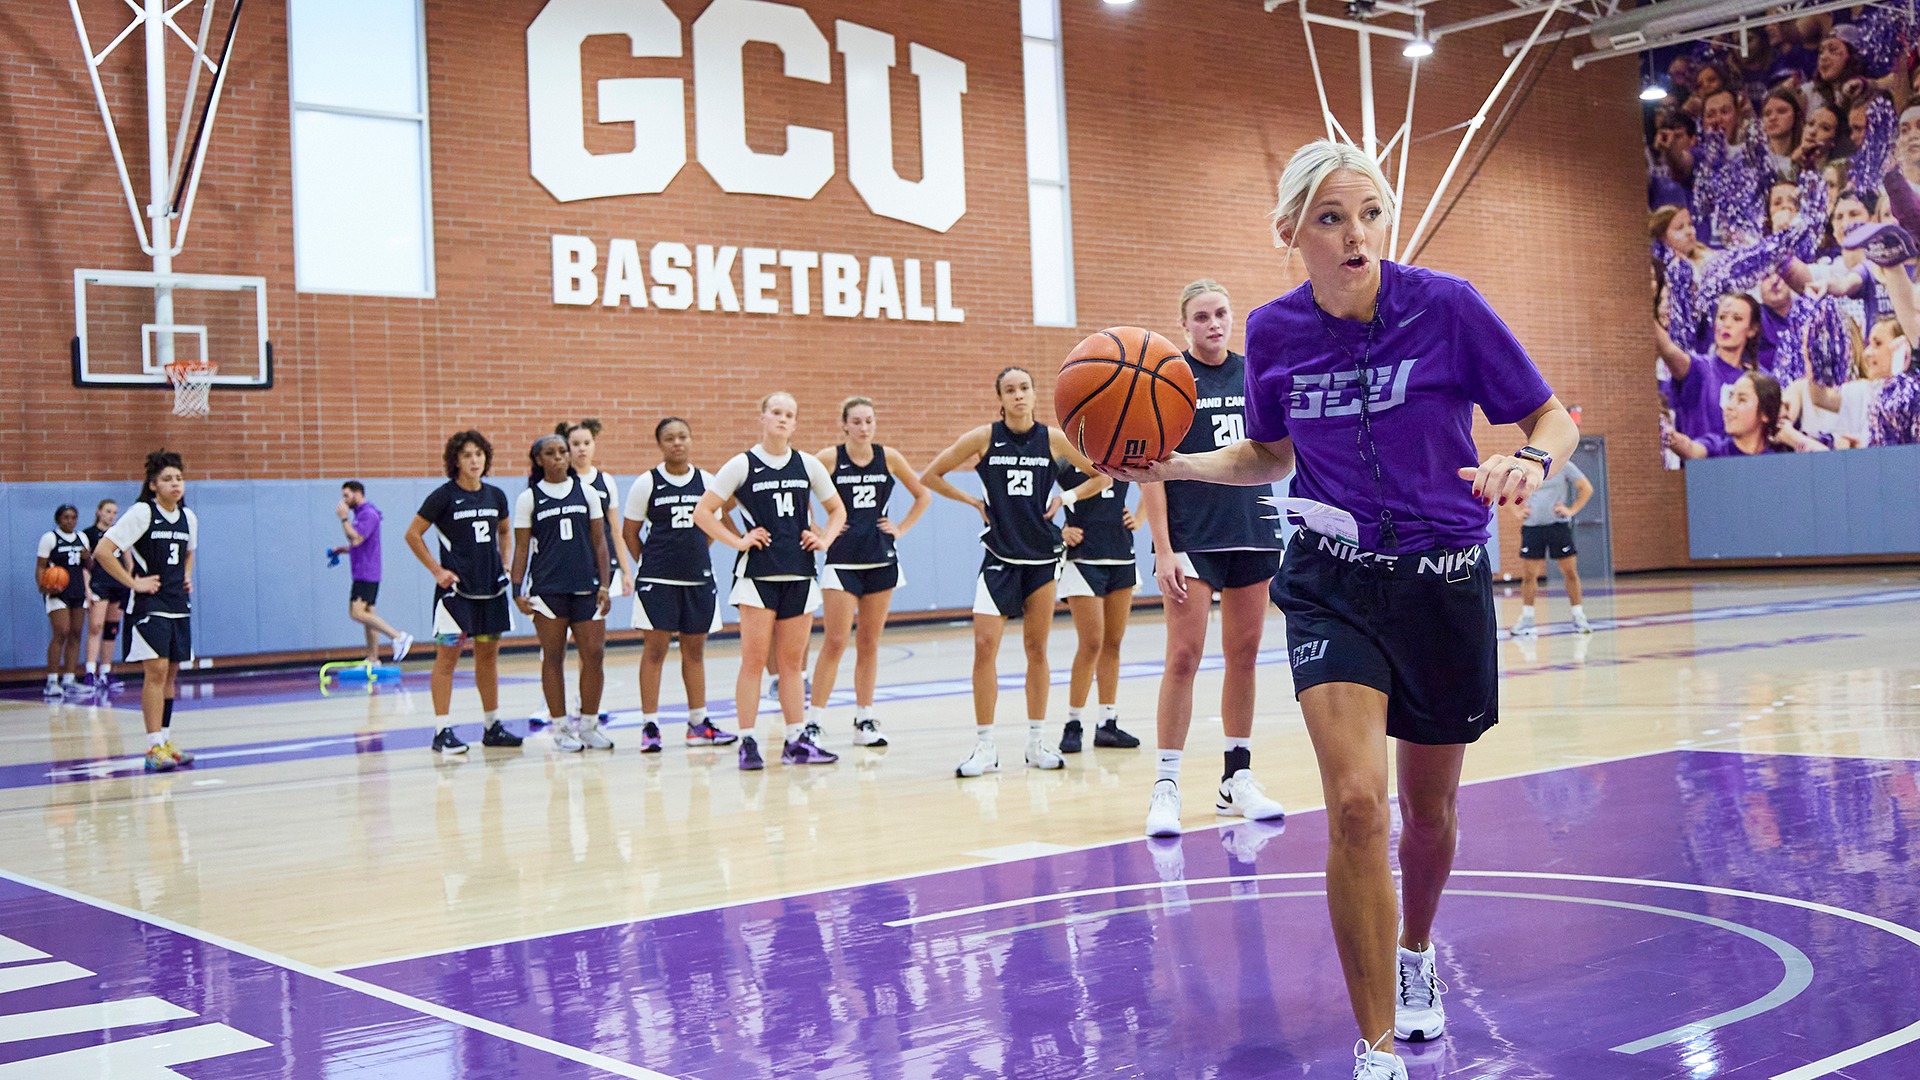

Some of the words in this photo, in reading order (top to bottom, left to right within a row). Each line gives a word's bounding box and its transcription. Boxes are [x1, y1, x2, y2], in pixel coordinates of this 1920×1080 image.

[526, 0, 968, 233] GCU
[552, 234, 966, 323] BASKETBALL
[1289, 358, 1419, 418] GCU
[1196, 397, 1222, 409] RAND
[1225, 396, 1245, 407] CAN
[1211, 414, 1245, 447] 20
[988, 456, 1017, 466] GRAND
[1018, 456, 1050, 468] CANYON
[1006, 469, 1034, 497] 23
[772, 492, 795, 517] 14
[852, 485, 877, 509] 22
[670, 505, 695, 529] 25
[472, 520, 492, 543] 12
[559, 518, 574, 541] 0
[167, 542, 180, 566] 3
[1292, 639, 1330, 669] GCU
